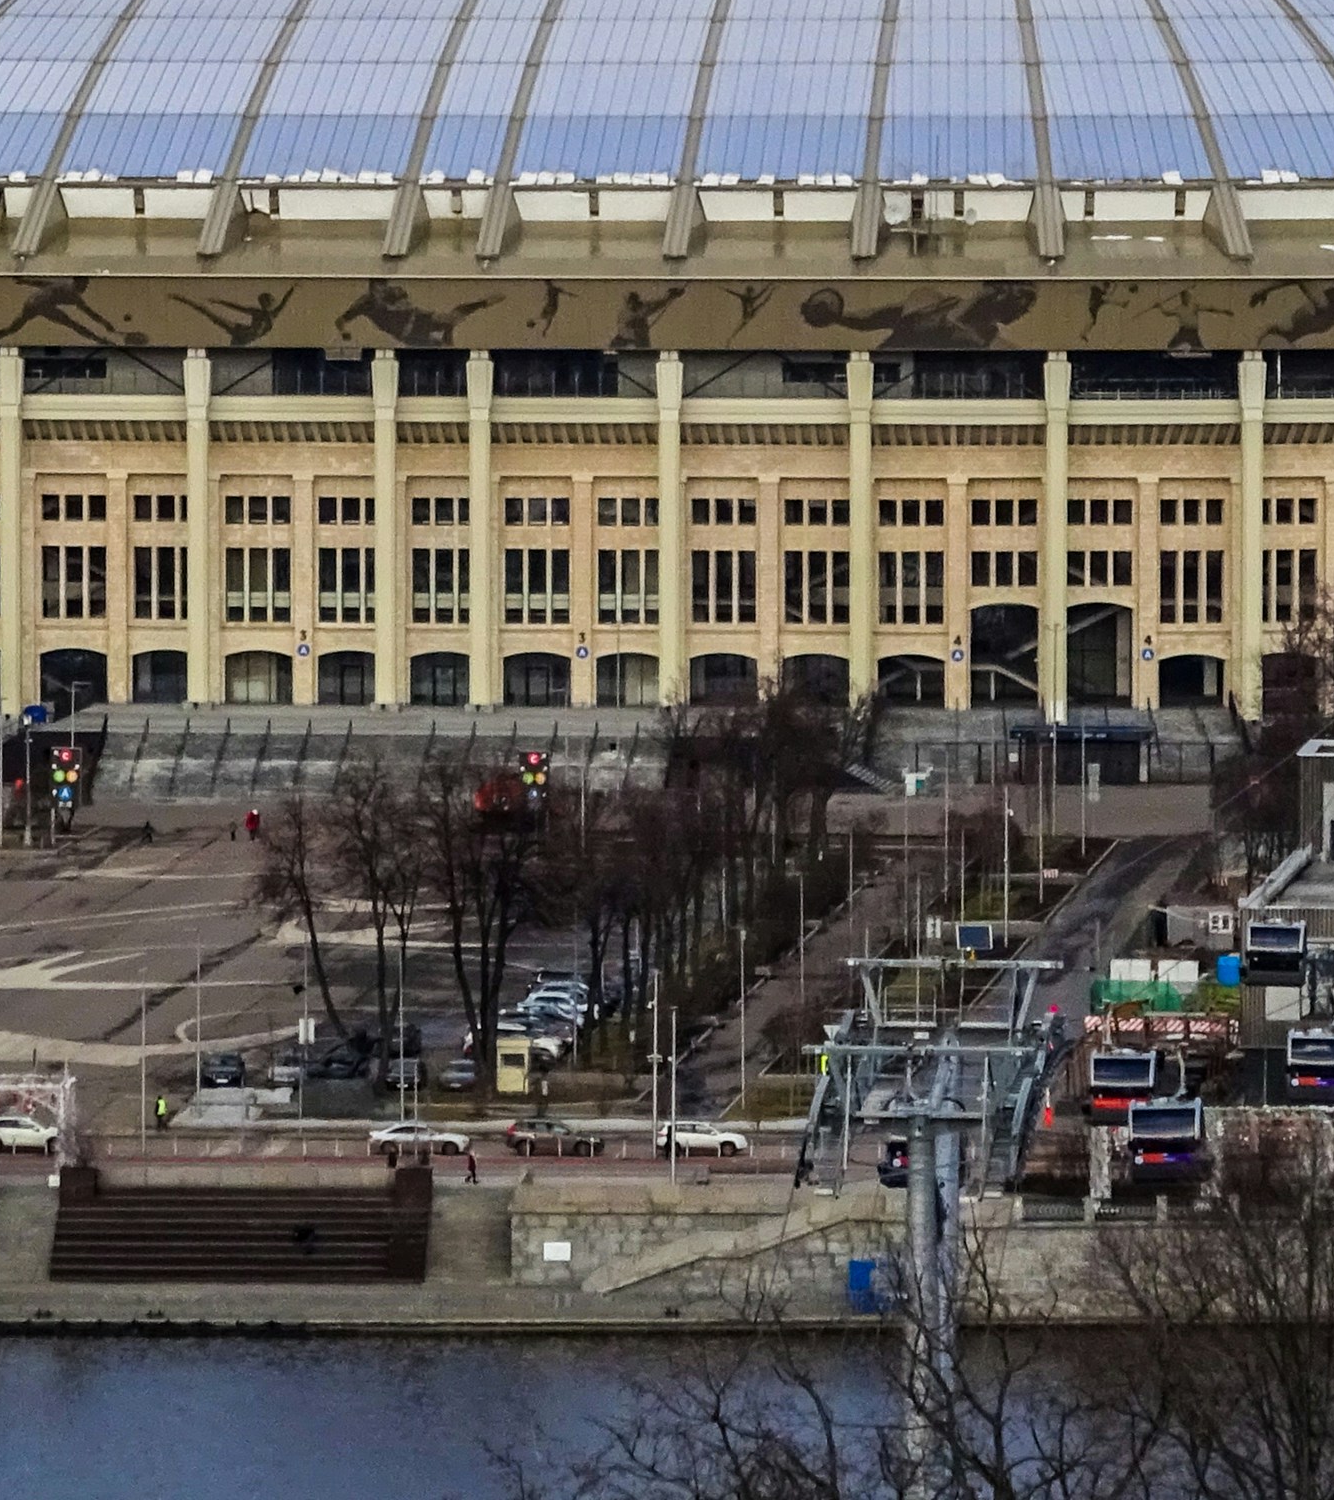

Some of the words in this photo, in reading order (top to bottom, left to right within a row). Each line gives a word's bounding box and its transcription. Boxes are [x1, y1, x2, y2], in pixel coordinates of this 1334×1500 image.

[299, 629, 307, 641] 3
[578, 632, 586, 643] 3
[953, 635, 962, 645] 4
[1144, 635, 1152, 646] 4
